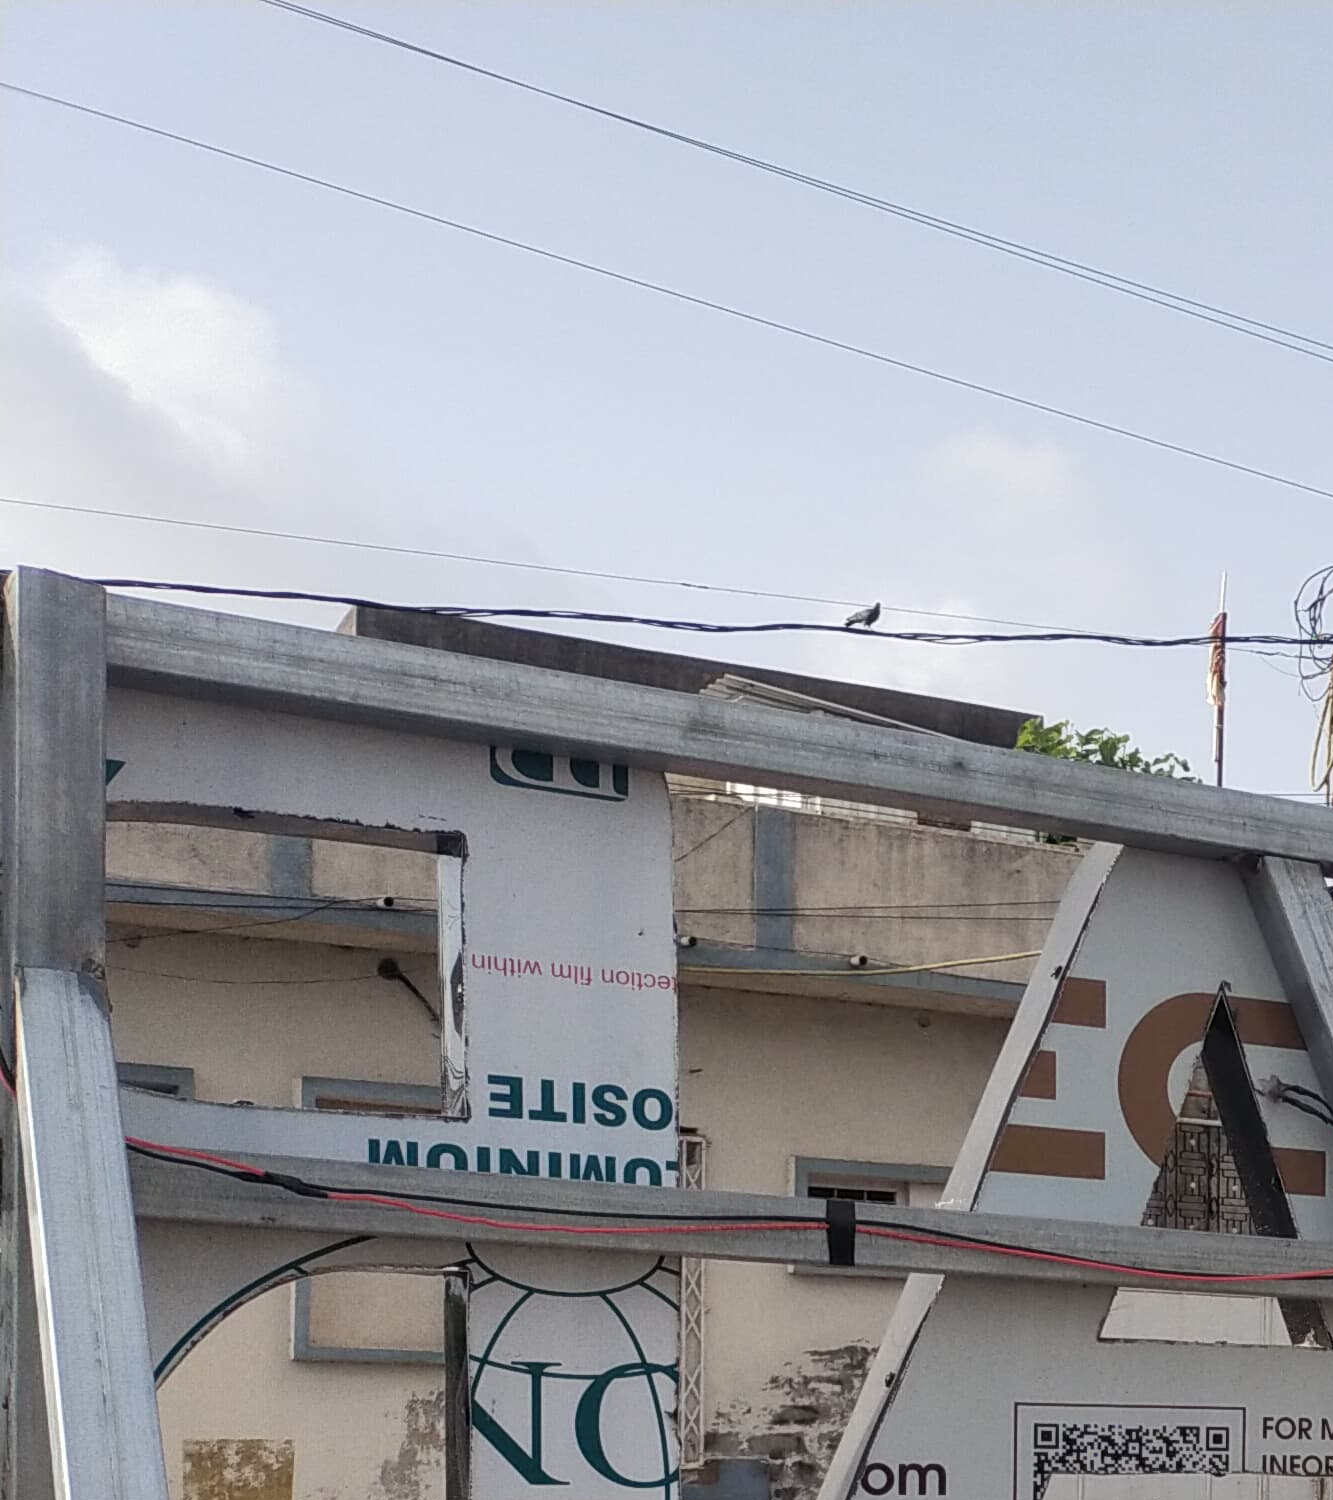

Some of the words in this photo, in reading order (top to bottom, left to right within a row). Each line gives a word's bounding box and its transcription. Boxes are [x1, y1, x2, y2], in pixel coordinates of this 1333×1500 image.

[471, 952, 544, 978] within
[549, 964, 594, 986] film
[486, 1074, 675, 1132] OSITE
[368, 1138, 679, 1188] UMINIUM
[1262, 1416, 1313, 1442] FOR
